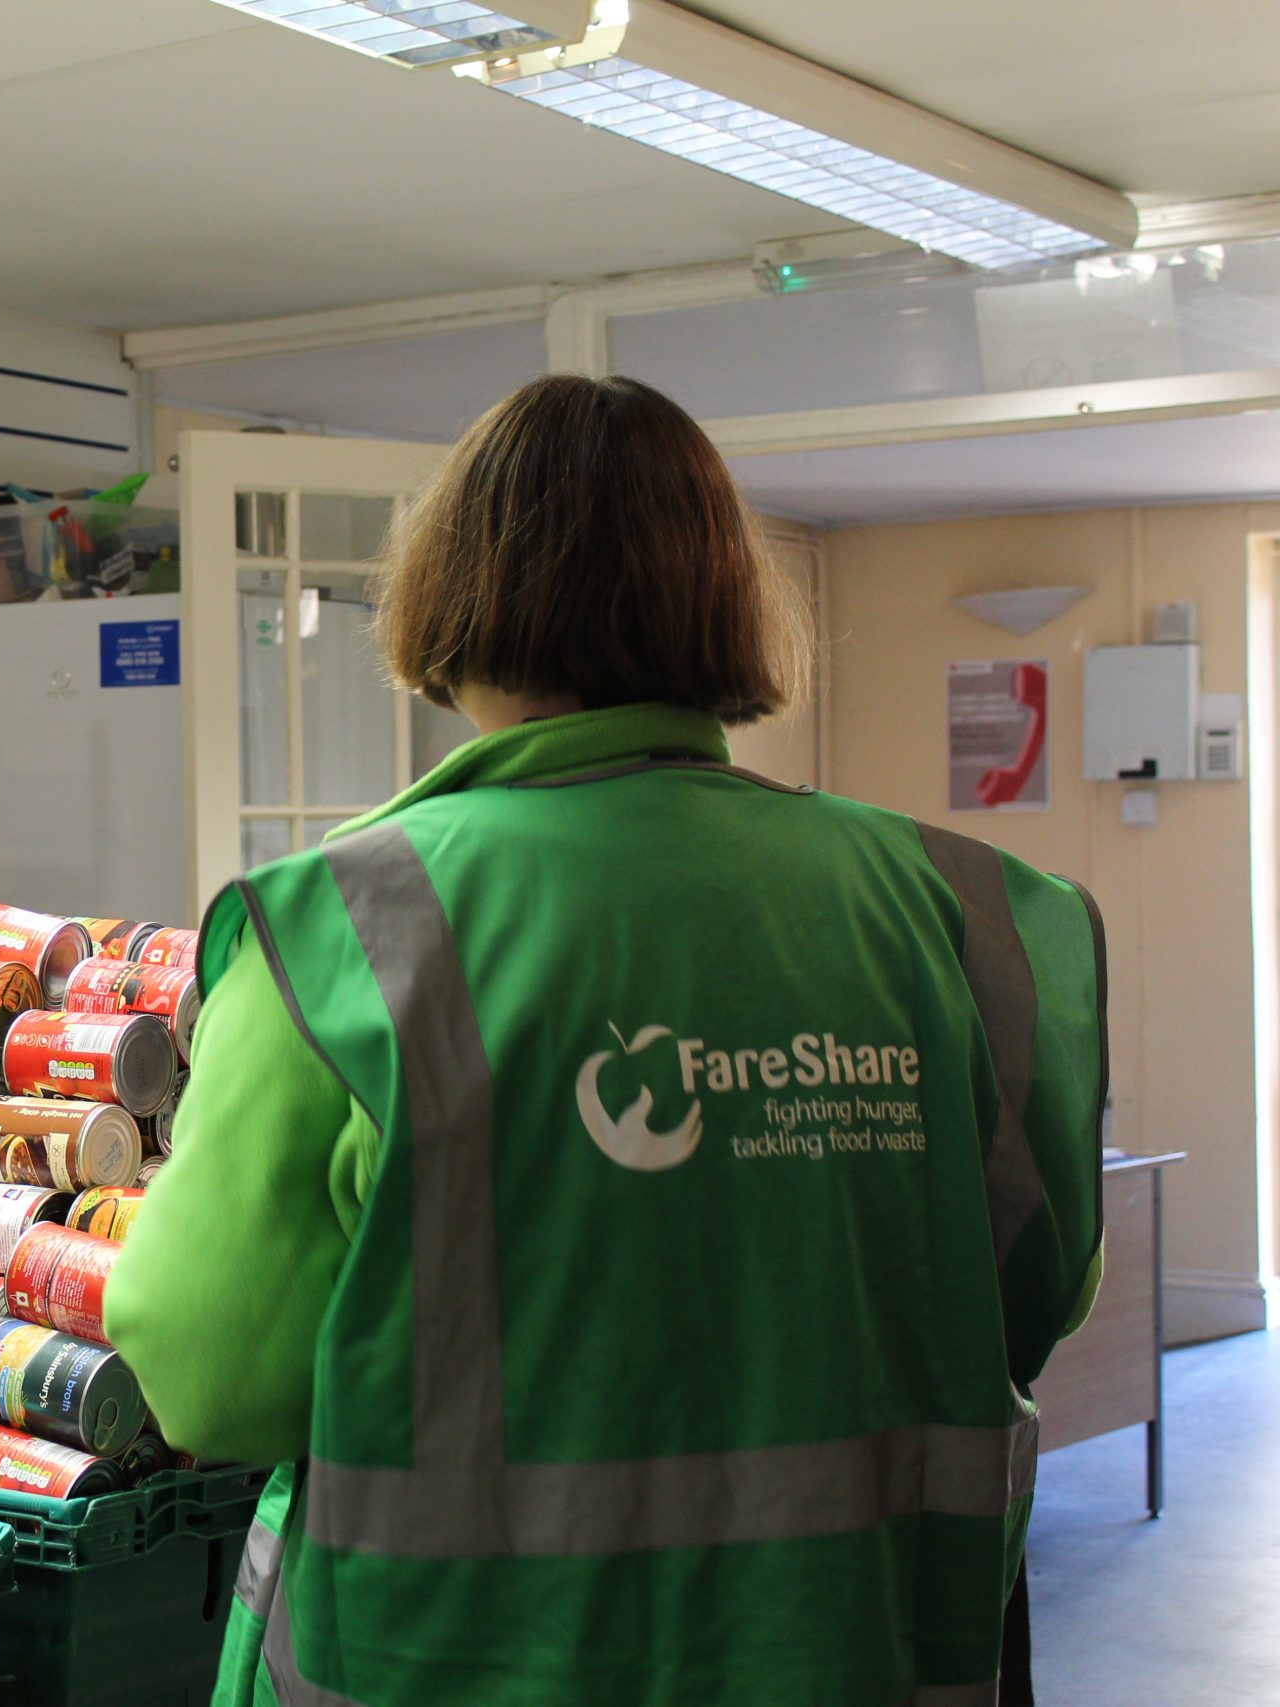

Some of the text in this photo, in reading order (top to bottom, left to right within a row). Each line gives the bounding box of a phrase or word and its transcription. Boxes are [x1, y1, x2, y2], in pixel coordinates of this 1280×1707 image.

[677, 1032, 920, 1093] FareShare
[730, 1126, 926, 1160] tackling food waste
[764, 1095, 922, 1130] fighting hunger,
[39, 1342, 79, 1409] by Sainsbury's
[61, 1347, 101, 1412] Scotch broth
